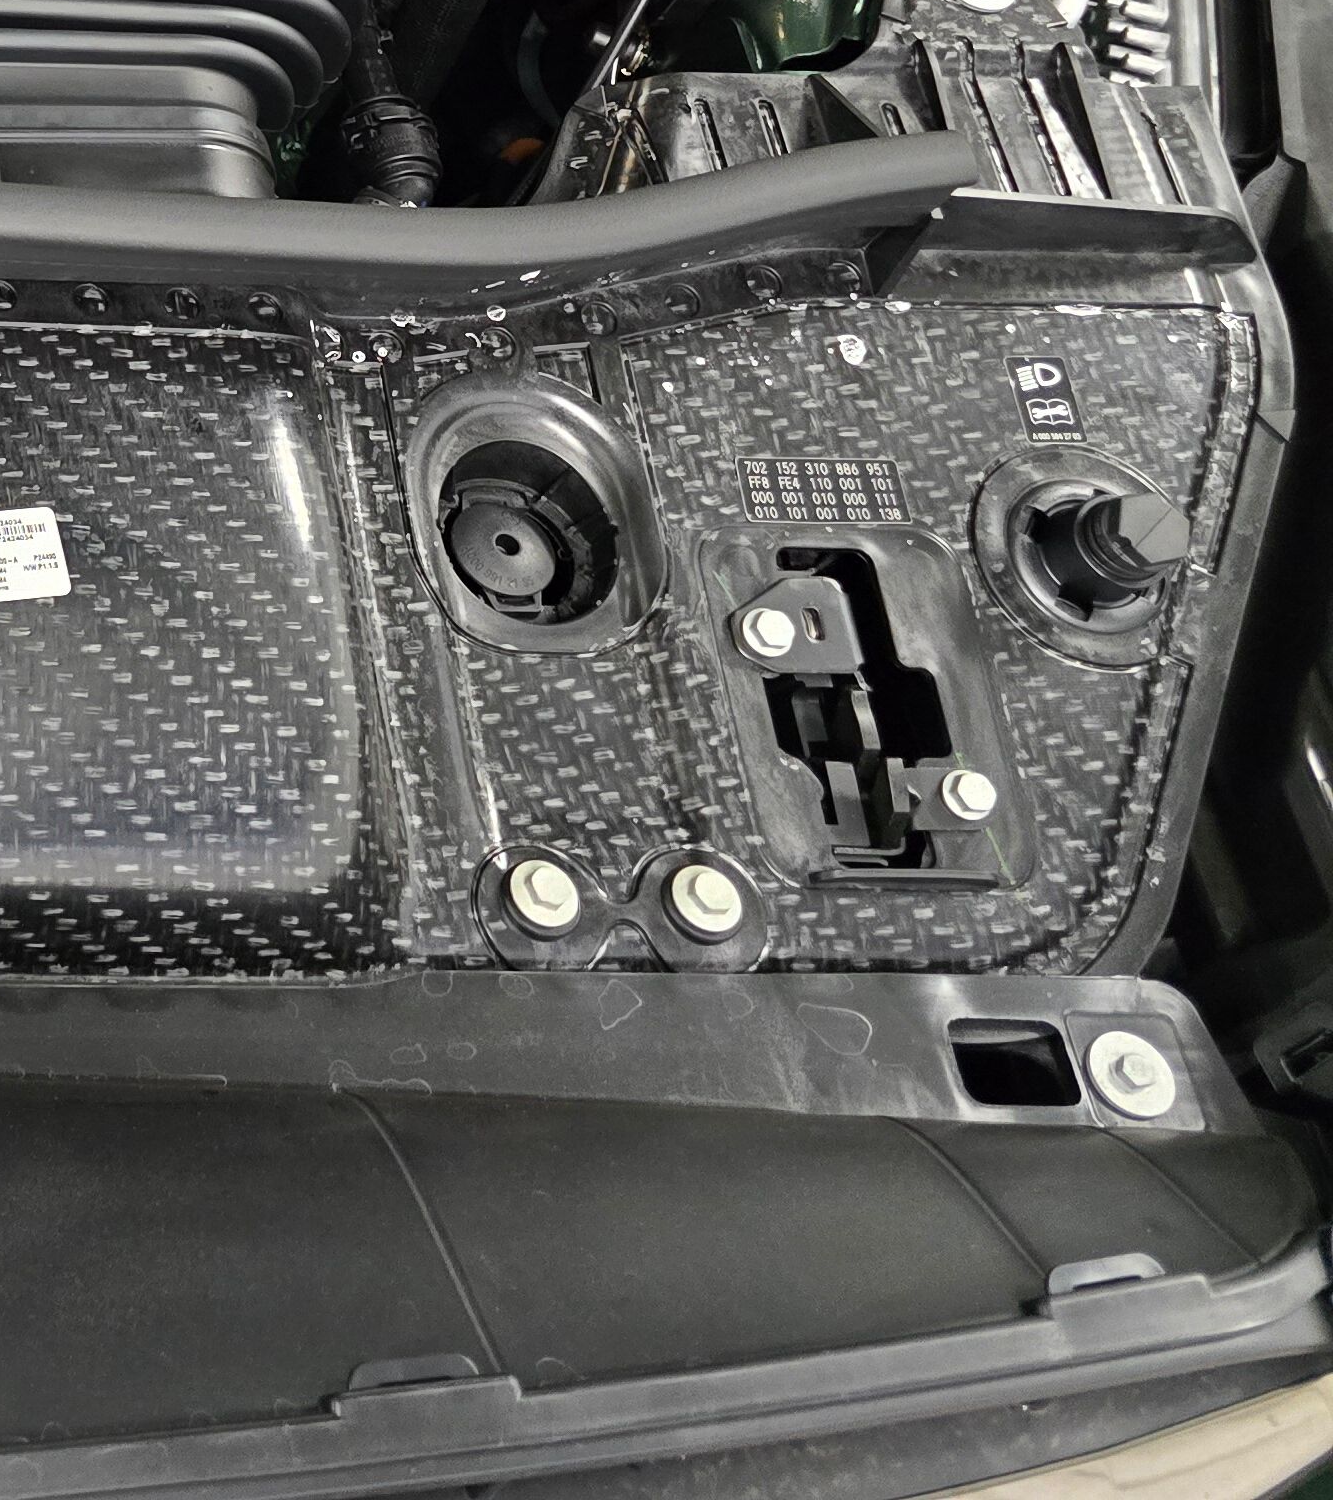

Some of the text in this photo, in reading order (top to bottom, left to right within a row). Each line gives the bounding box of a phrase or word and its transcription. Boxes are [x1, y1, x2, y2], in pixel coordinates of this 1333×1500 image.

[744, 461, 889, 476] 702 152 310 886 951
[749, 477, 893, 491] FF8 FE4 110 001 101
[751, 491, 897, 506] 000 001 010 000 111
[755, 506, 901, 521] 010 101 001 010 138
